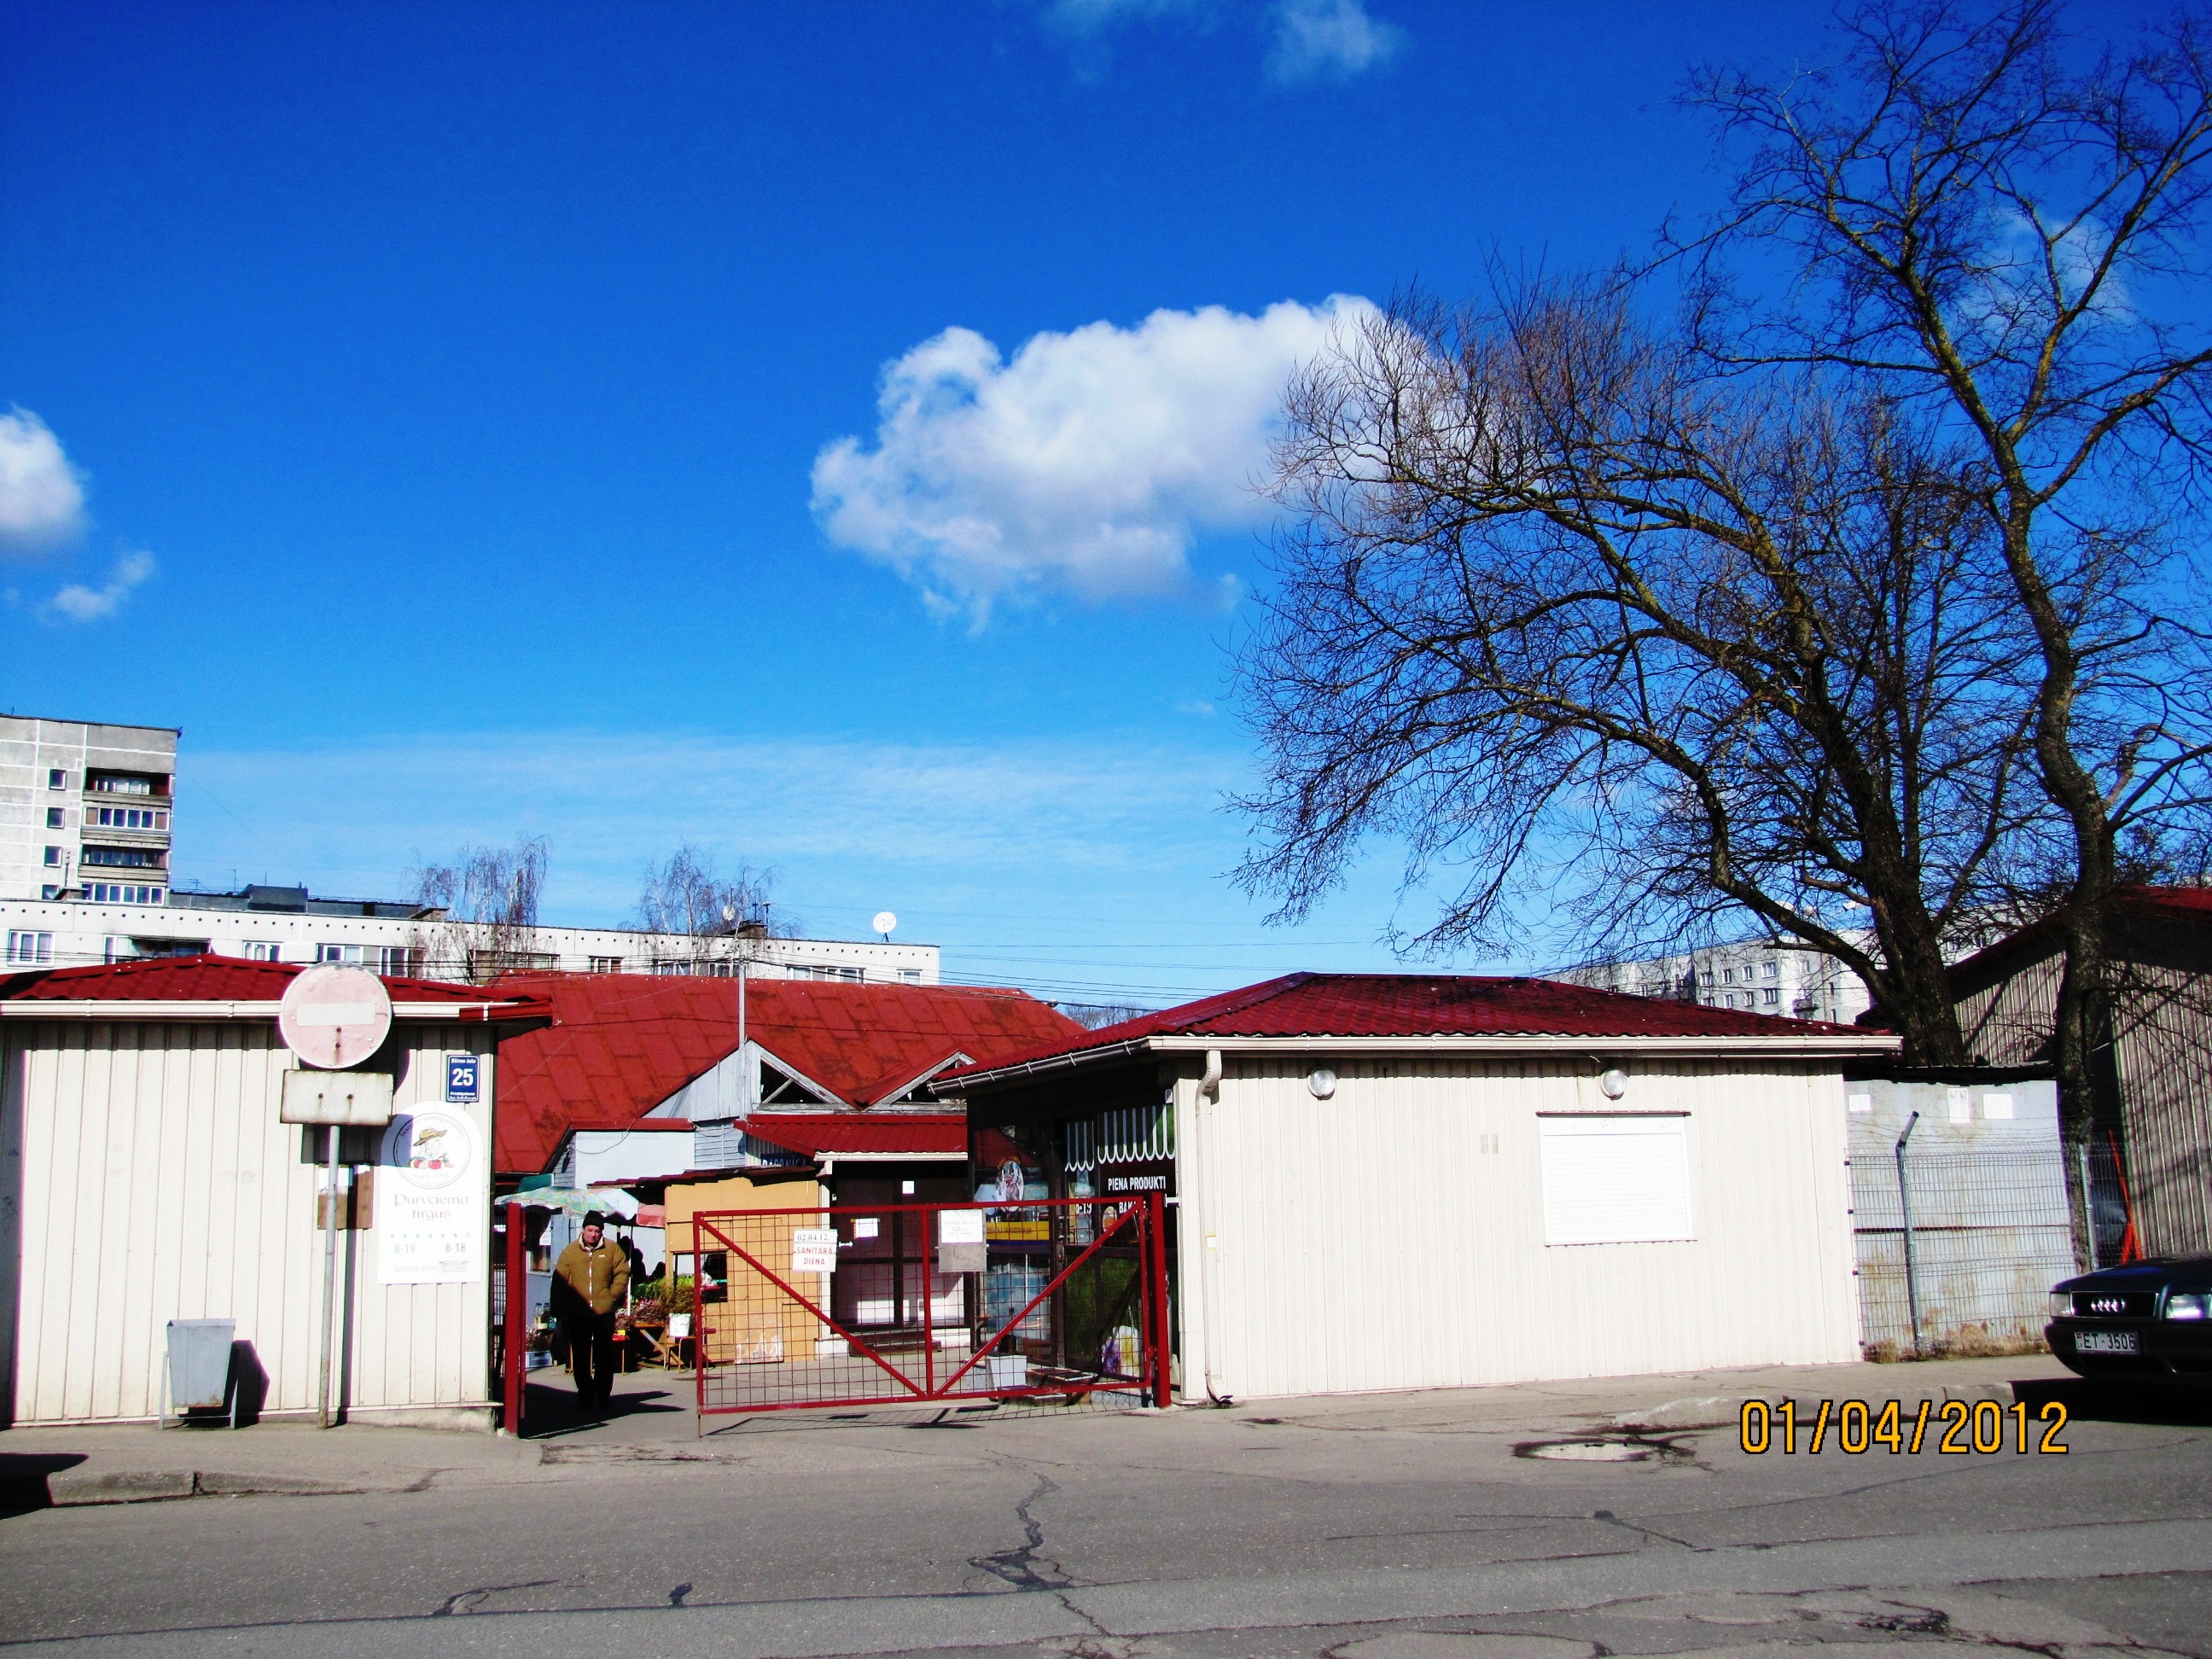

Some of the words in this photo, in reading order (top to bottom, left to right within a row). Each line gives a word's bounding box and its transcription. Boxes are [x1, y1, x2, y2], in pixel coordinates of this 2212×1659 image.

[451, 1068, 474, 1086] 25
[1108, 1178, 1128, 1190] PIENA
[1129, 1176, 1167, 1190] PRODUKTI
[393, 1193, 469, 1208] Purvciema
[412, 1208, 451, 1221] tirgus
[393, 1243, 416, 1254] 8-19
[445, 1243, 467, 1253] 8-18
[803, 1257, 825, 1266] DIENA
